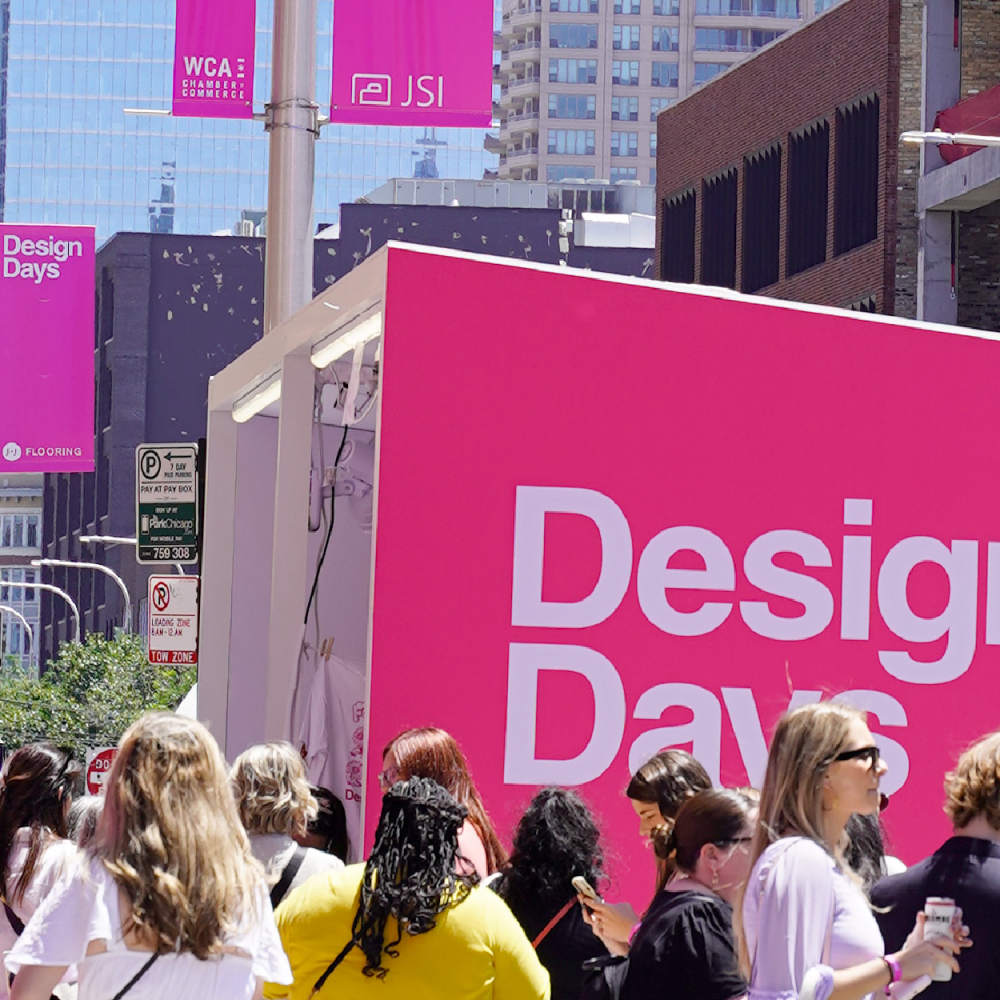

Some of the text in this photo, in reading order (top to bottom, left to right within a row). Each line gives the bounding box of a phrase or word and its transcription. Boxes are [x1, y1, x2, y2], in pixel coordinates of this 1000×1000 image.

[183, 56, 232, 77] WCA
[182, 79, 237, 89] CHAMBER
[182, 88, 244, 99] COMMERCE
[400, 74, 444, 107] JSI
[4, 234, 82, 262] Design
[4, 256, 60, 284] Days
[25, 446, 82, 457] FLOORING
[140, 485, 154, 493] PAY
[163, 485, 177, 493] PAY
[178, 485, 193, 493] BOX
[150, 518, 193, 530] ParkChicago
[153, 547, 170, 559] 759
[171, 547, 190, 559] 308
[151, 617, 191, 627] LOADING ZONE
[151, 651, 195, 663] TOW ZONE
